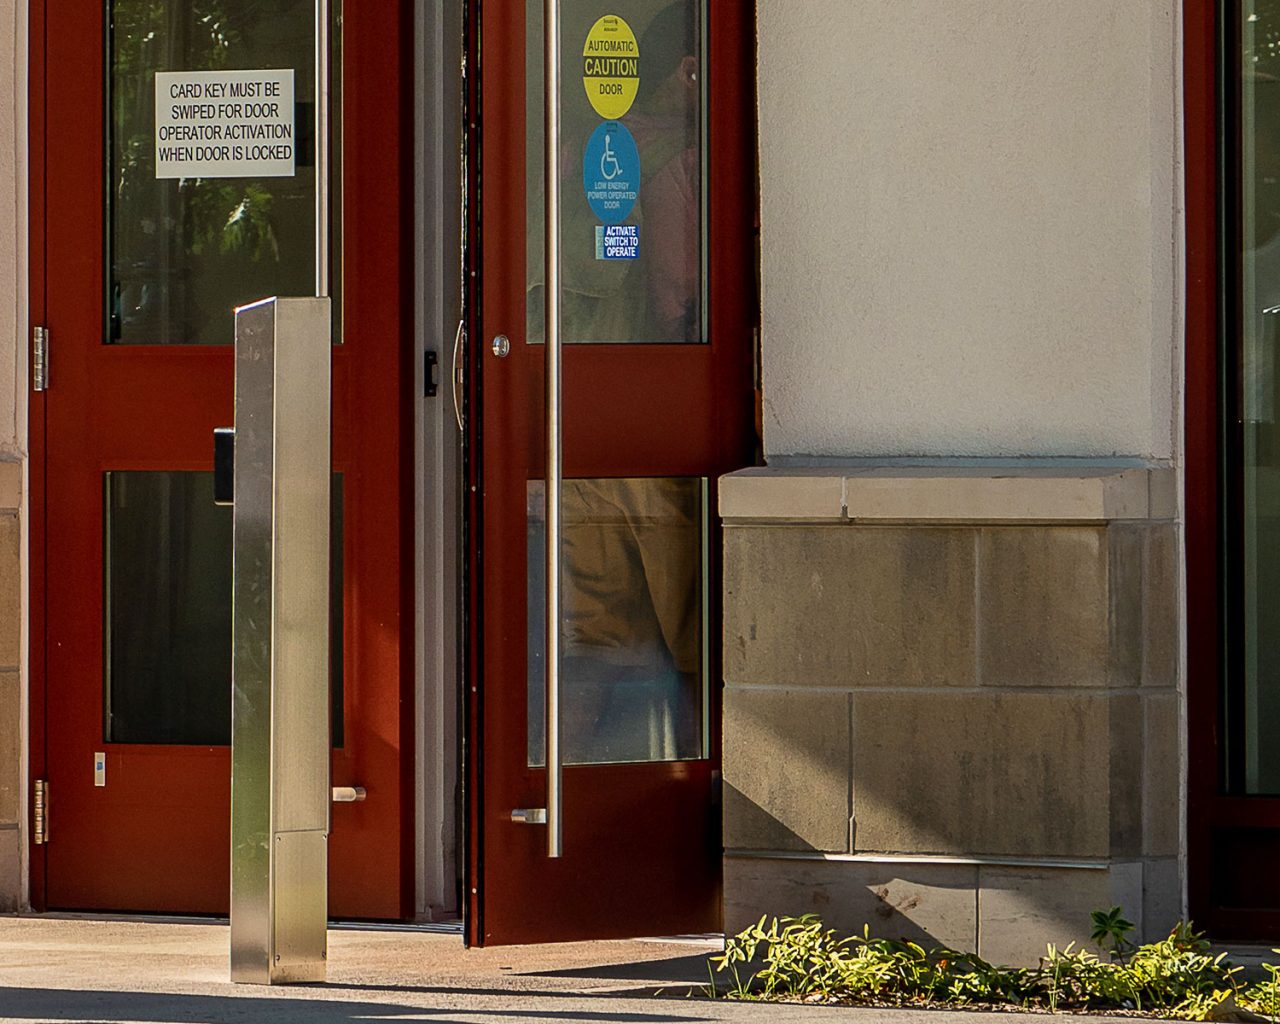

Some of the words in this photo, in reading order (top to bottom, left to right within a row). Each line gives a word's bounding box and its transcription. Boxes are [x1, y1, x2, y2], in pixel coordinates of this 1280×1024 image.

[588, 40, 633, 51] AUTOMATIC
[585, 59, 637, 75] CAUTION
[170, 84, 202, 98] CARD
[205, 83, 227, 98] KEY
[230, 82, 262, 97] MUST
[265, 82, 280, 97] BE
[600, 84, 622, 94] DOOR
[171, 104, 215, 119] SWIPED
[218, 104, 242, 119] FOR
[245, 103, 279, 118] DOOR
[159, 125, 221, 140] OPERATOR
[224, 124, 292, 140] ACTIVATION
[159, 147, 193, 161] WHEN
[196, 146, 229, 161] DOOR
[232, 146, 243, 160] IS
[246, 145, 292, 160] LOCKED
[594, 182, 606, 190] LOW
[608, 182, 629, 190] ENERGY
[604, 201, 620, 209] DOOR
[606, 226, 636, 236] ACTIVATE
[604, 237, 628, 247] SWITCH
[629, 237, 638, 246] TO
[606, 247, 636, 256] OPERATE
